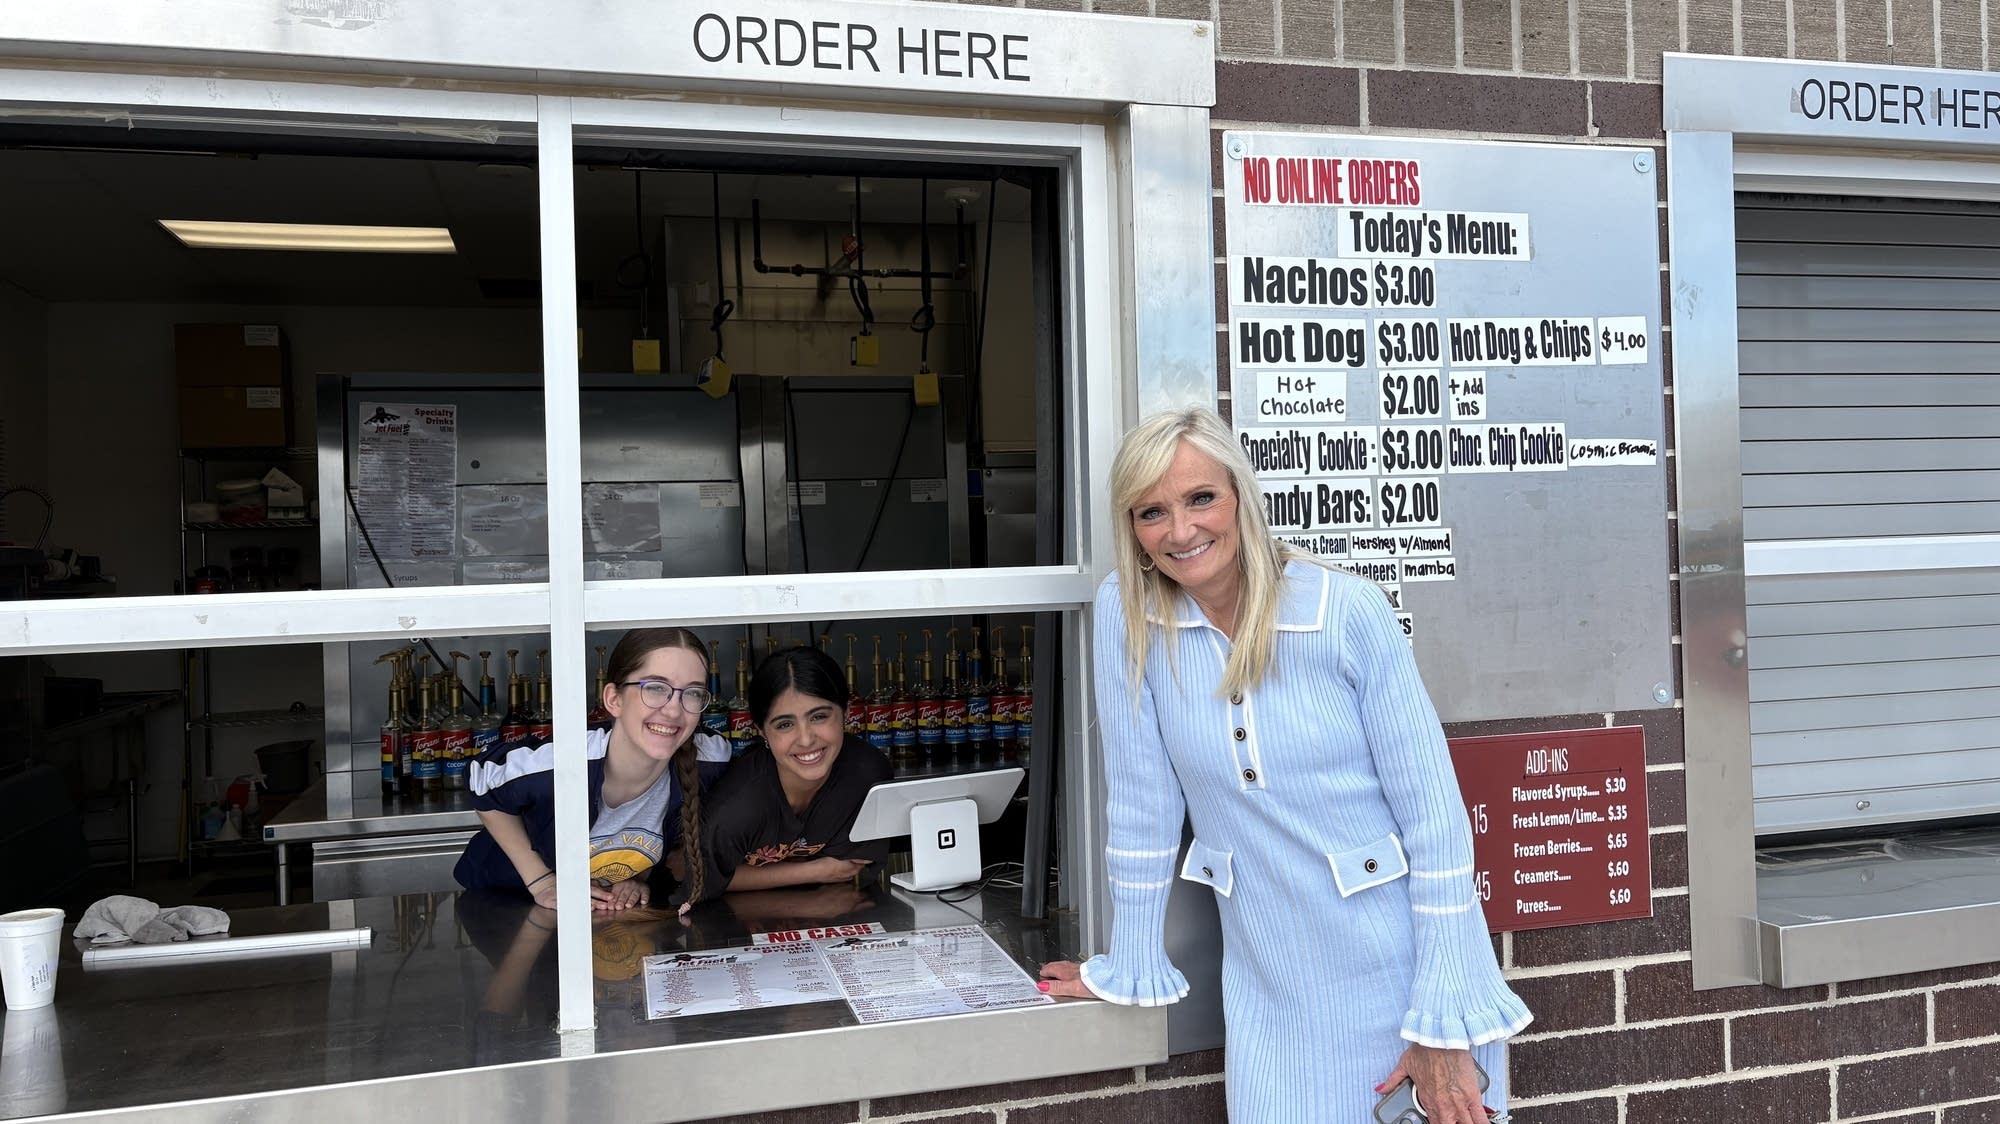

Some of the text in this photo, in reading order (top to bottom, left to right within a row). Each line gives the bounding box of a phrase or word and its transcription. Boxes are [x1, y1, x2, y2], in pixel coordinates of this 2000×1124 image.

[693, 12, 1030, 82] ORDER HERE
[1800, 78, 2000, 129] ORDER HER
[1243, 157, 1420, 206] NO ONLINE ORDERS
[1350, 211, 1517, 258] Today's Menu:
[1243, 257, 1435, 306] Nachos $3.00
[1240, 319, 1592, 368] Hot Dog $3.00 Hot Dog & Chips
[1277, 376, 1317, 394] Hot
[1463, 378, 1484, 396] Add
[1382, 373, 1440, 418] $2.00
[414, 408, 454, 418] Specialty
[1260, 397, 1346, 418] Chocolate
[1456, 397, 1480, 416] ins
[425, 417, 454, 425] Drinks
[1240, 430, 1311, 475] Specialty
[1382, 427, 1443, 473] $3.00
[1489, 427, 1517, 471] Chip
[1520, 426, 1564, 465] Cookie
[1262, 482, 1439, 529] andy Bars: $2.00
[1278, 535, 1348, 554] kies & Cream
[1352, 536, 1397, 554] Hershey
[1334, 562, 1397, 581] sketeers
[1404, 560, 1456, 577] mamba
[703, 718, 727, 729] Trani
[733, 717, 753, 731] Tora
[414, 737, 440, 752] Torani
[443, 736, 470, 751] Torani
[472, 731, 500, 749] Torani
[1526, 748, 1569, 774] ADD-INS
[1512, 784, 1553, 802] Flavored
[1605, 777, 1626, 794] $.30
[1512, 812, 1538, 829] Fresh
[1608, 804, 1628, 822] $.35
[622, 833, 661, 855] VALL
[1514, 842, 1546, 858] Frozen
[1607, 832, 1628, 850] $.65
[1608, 860, 1629, 878] $.60
[1609, 888, 1631, 906] $.60
[768, 924, 873, 943] NO CASH
[744, 942, 811, 952] Fountain
